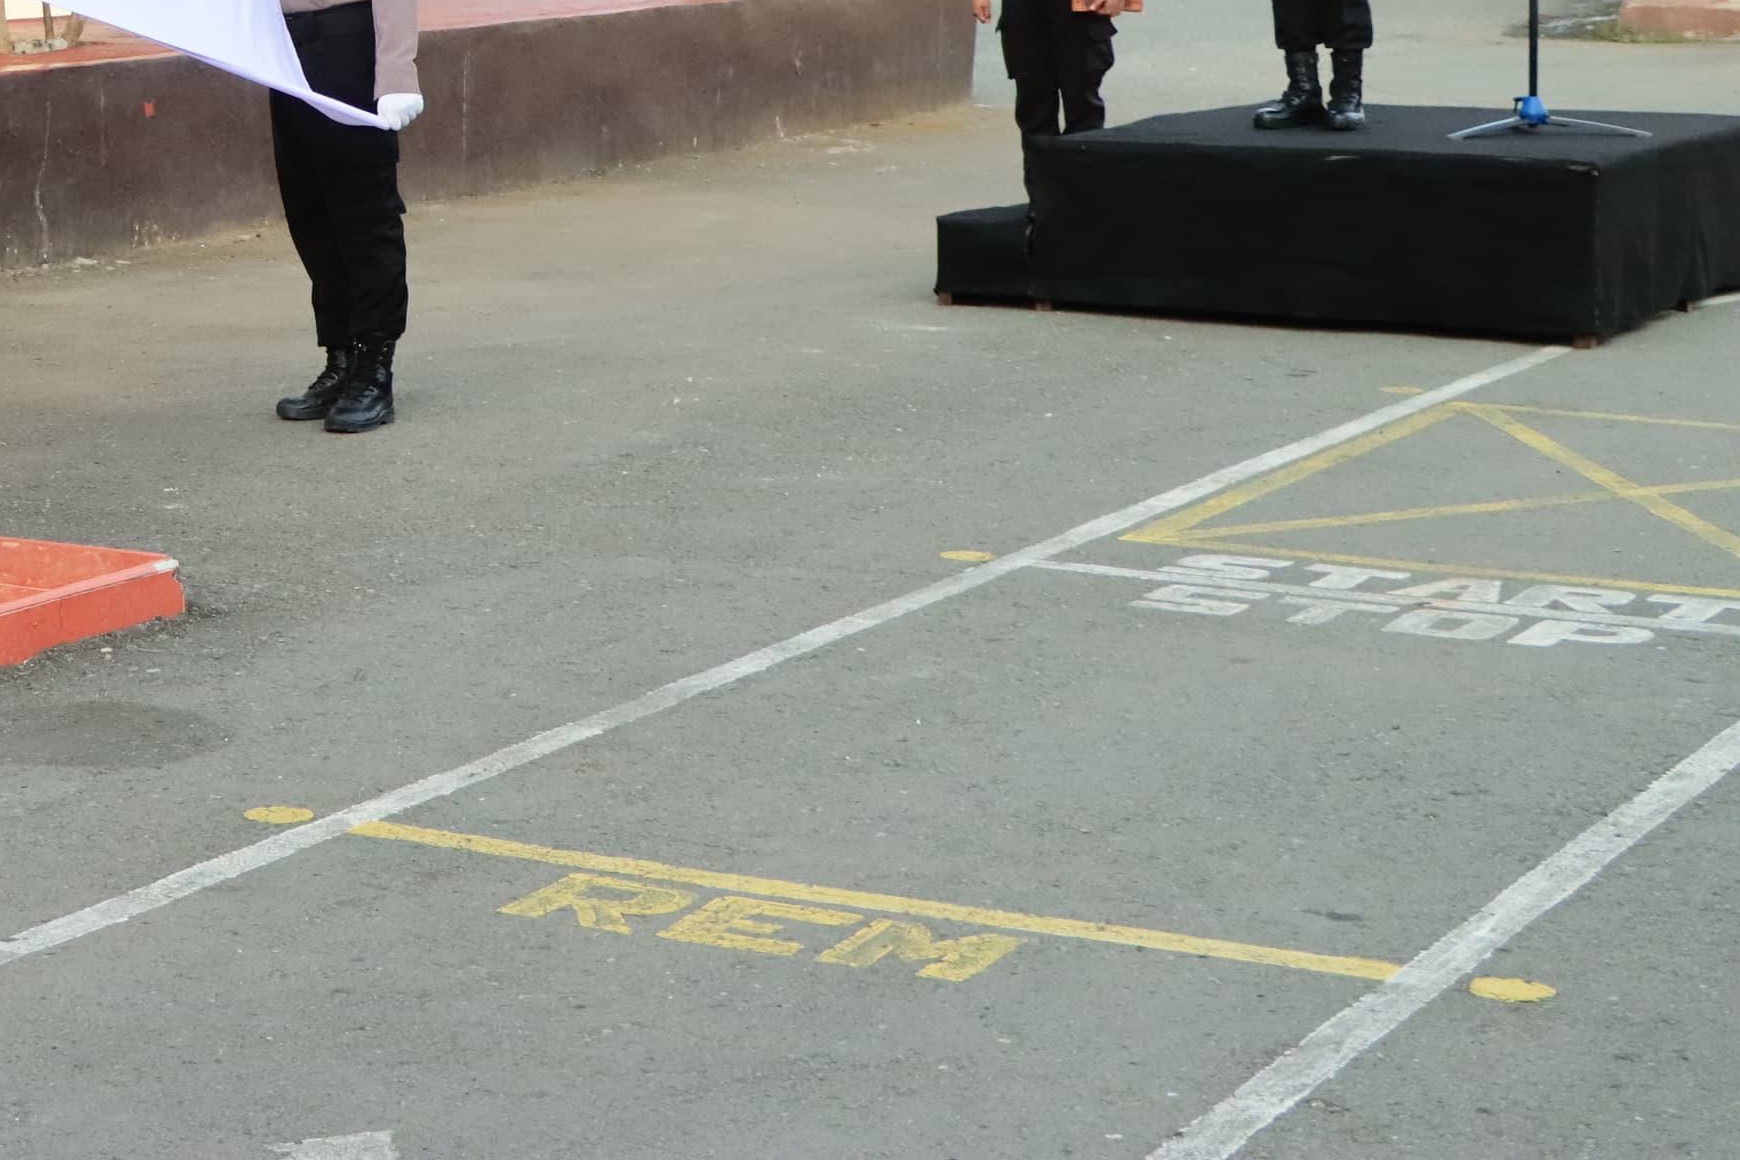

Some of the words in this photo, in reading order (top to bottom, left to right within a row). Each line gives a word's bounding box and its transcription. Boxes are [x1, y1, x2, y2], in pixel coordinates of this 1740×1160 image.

[1129, 583, 1655, 647] STOP
[1157, 553, 1740, 627] START
[496, 872, 1024, 982] REM
